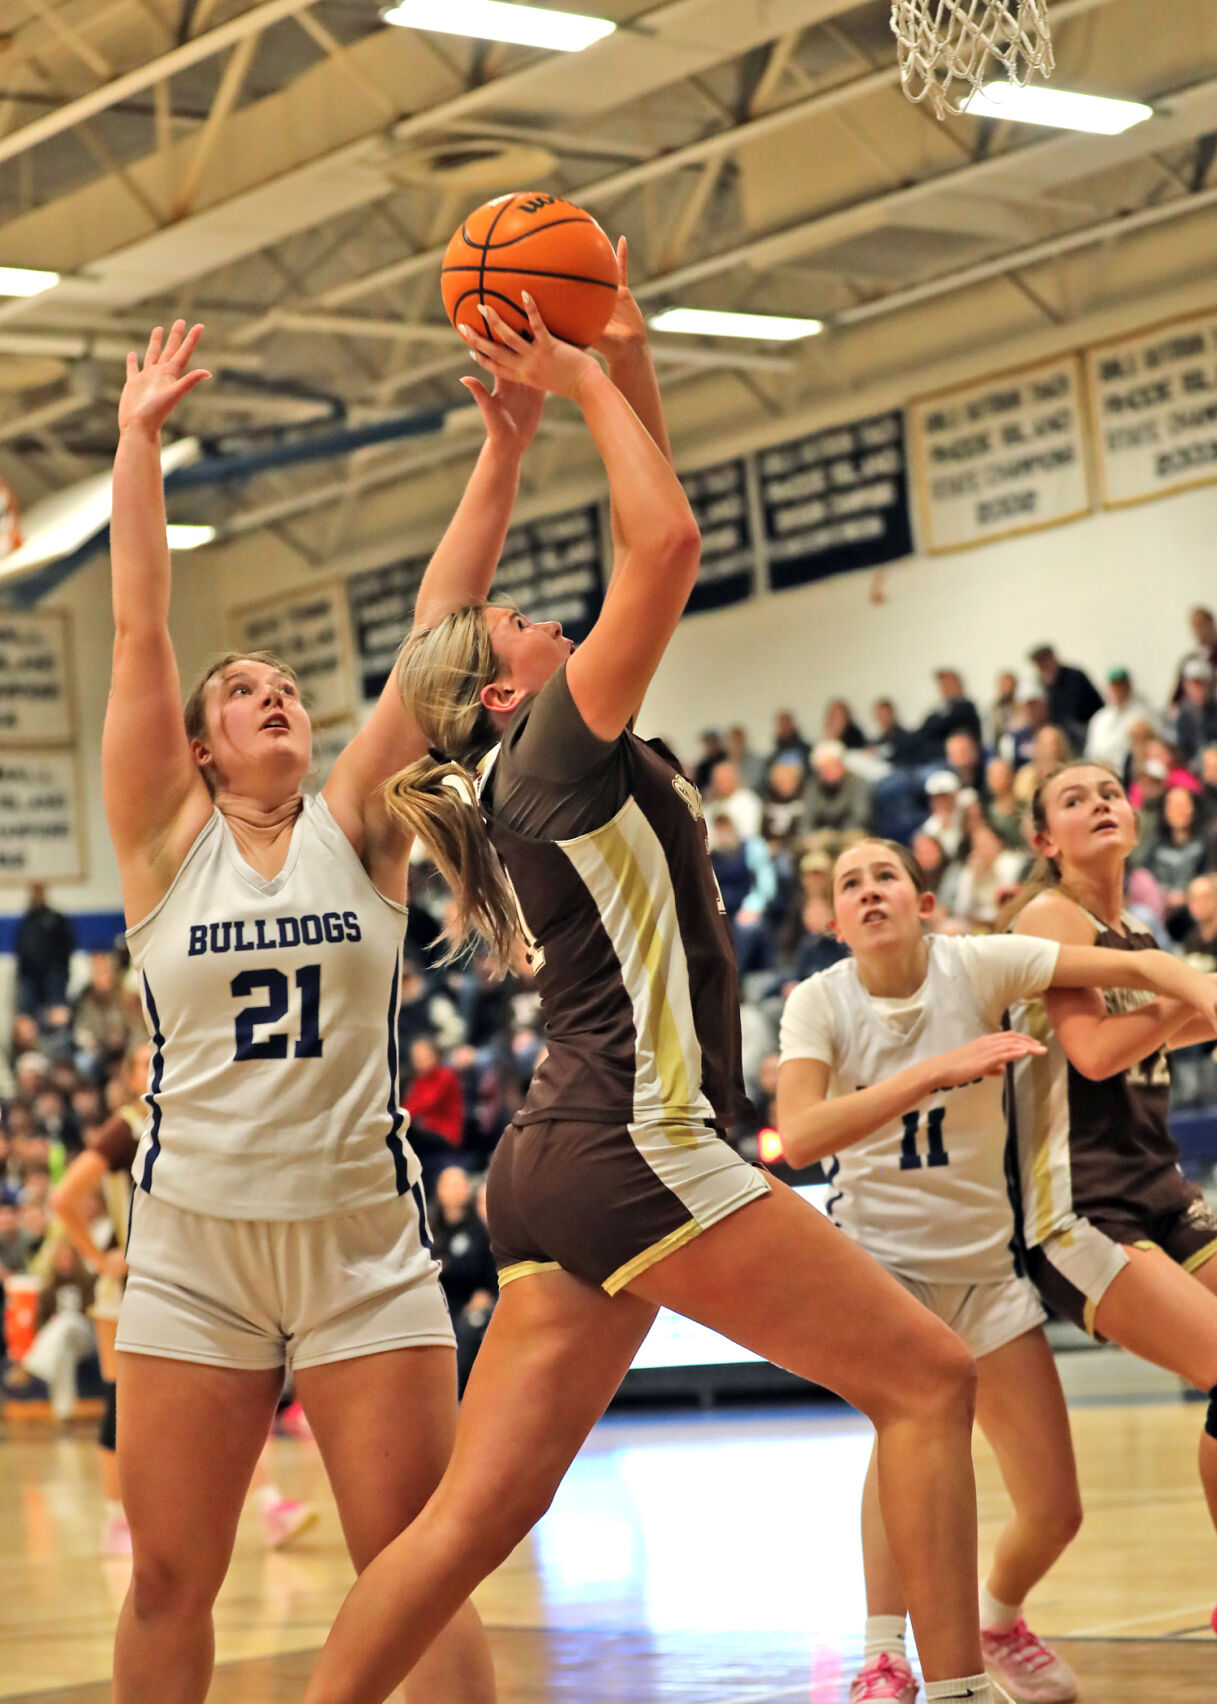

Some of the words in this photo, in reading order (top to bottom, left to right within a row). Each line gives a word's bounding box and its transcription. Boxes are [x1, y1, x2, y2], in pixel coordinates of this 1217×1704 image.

[188, 911, 362, 957] BULLDOGS
[230, 963, 323, 1062] 21
[899, 1106, 949, 1171] 11
